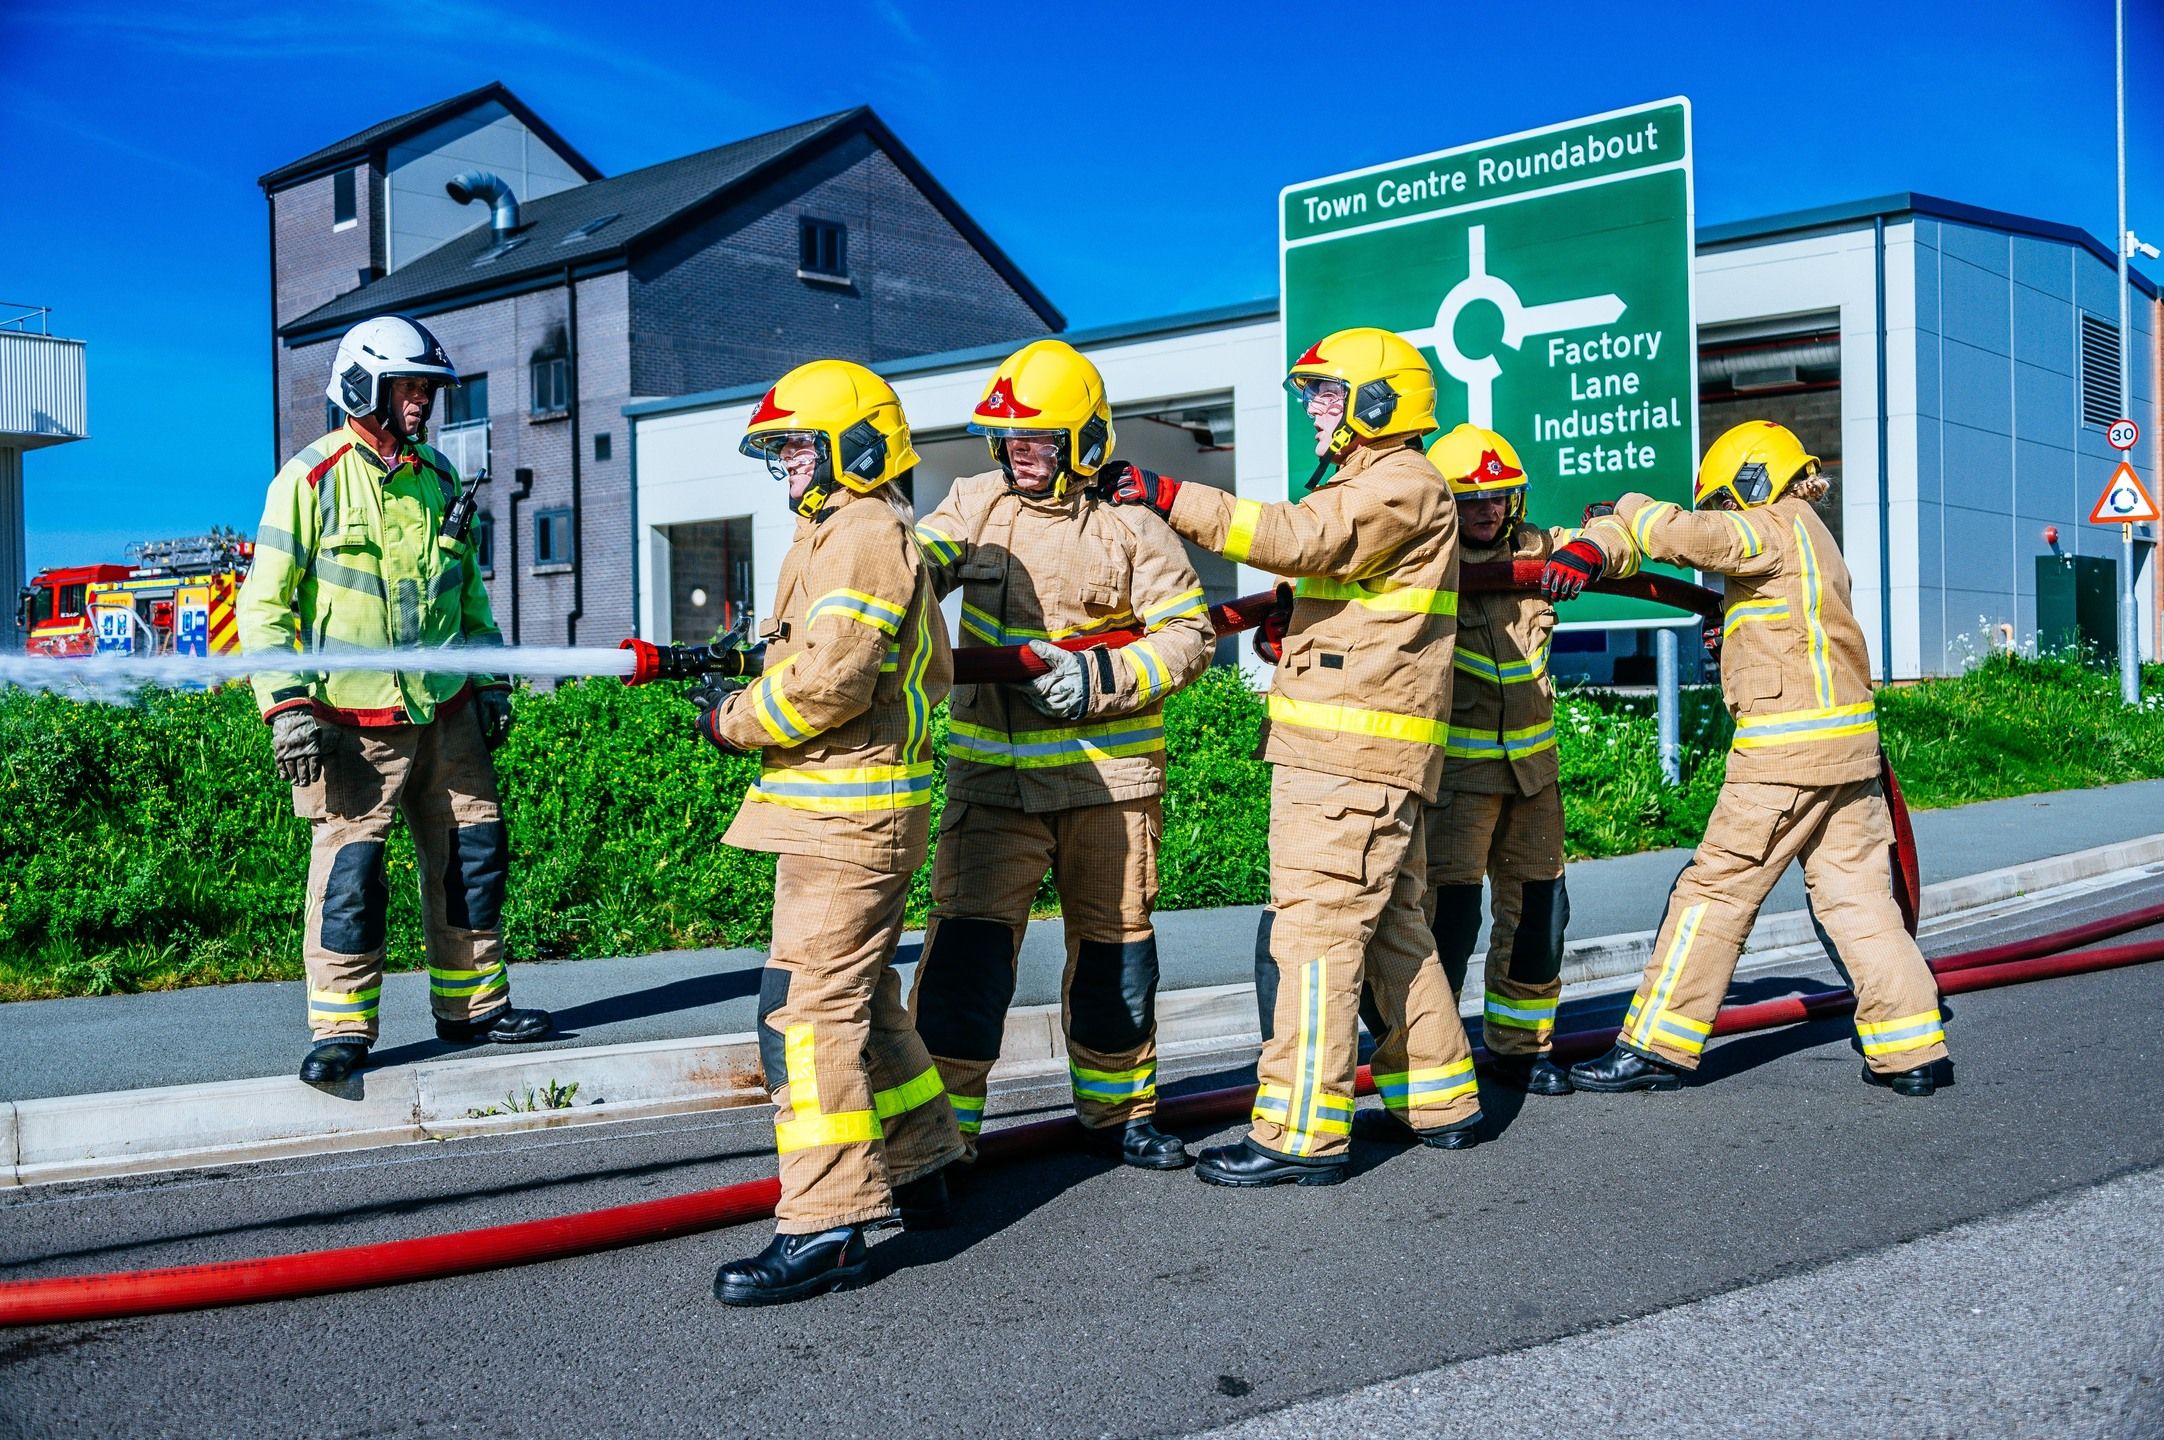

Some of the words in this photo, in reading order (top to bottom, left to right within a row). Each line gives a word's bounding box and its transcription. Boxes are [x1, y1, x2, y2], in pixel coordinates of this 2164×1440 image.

[1303, 192, 1367, 224] Town
[1376, 170, 1467, 208] Centre
[1478, 121, 1658, 187] Roundabout
[1548, 330, 1662, 367] Factory
[1570, 371, 1640, 401] Lane
[1534, 397, 1681, 442] Industrial
[2111, 427, 2134, 441] 30
[1558, 440, 1656, 476] Estate
